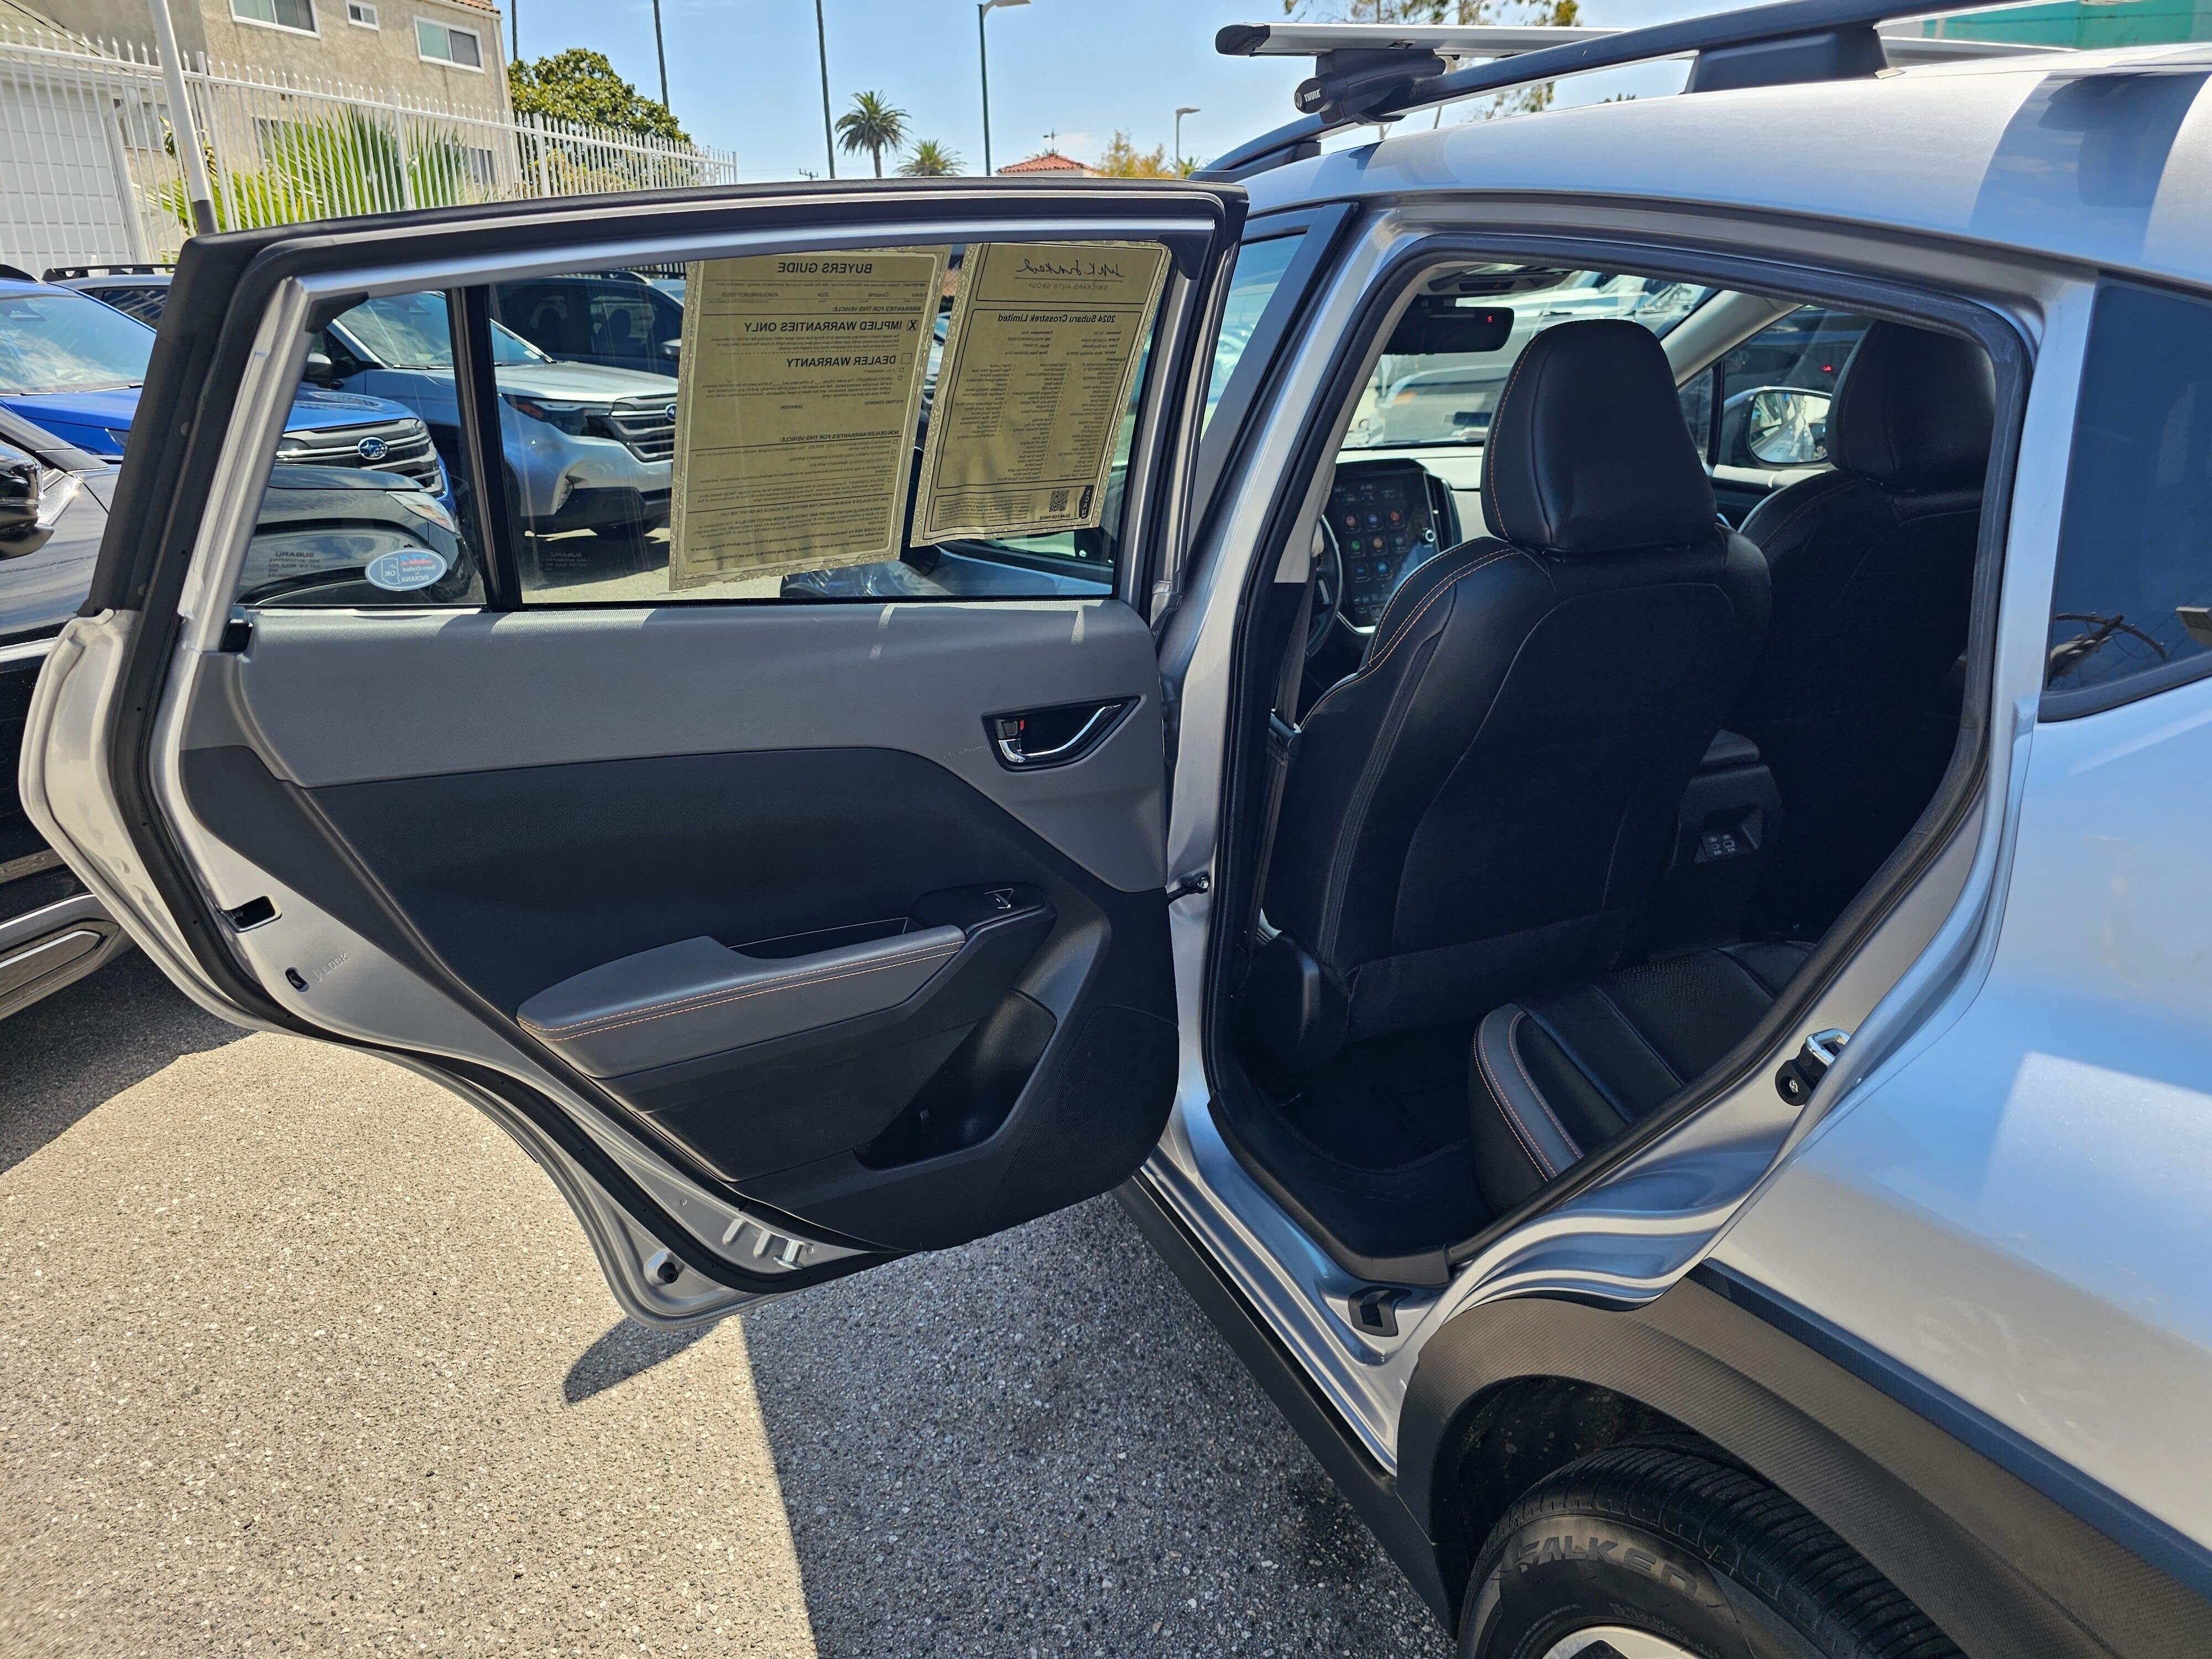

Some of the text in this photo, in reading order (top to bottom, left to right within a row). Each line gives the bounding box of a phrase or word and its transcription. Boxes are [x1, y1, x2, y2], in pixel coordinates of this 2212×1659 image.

[1304, 89, 1321, 102] THULE
[321, 952, 349, 974] LOCK
[1515, 1536, 1698, 1601] FALKEN
